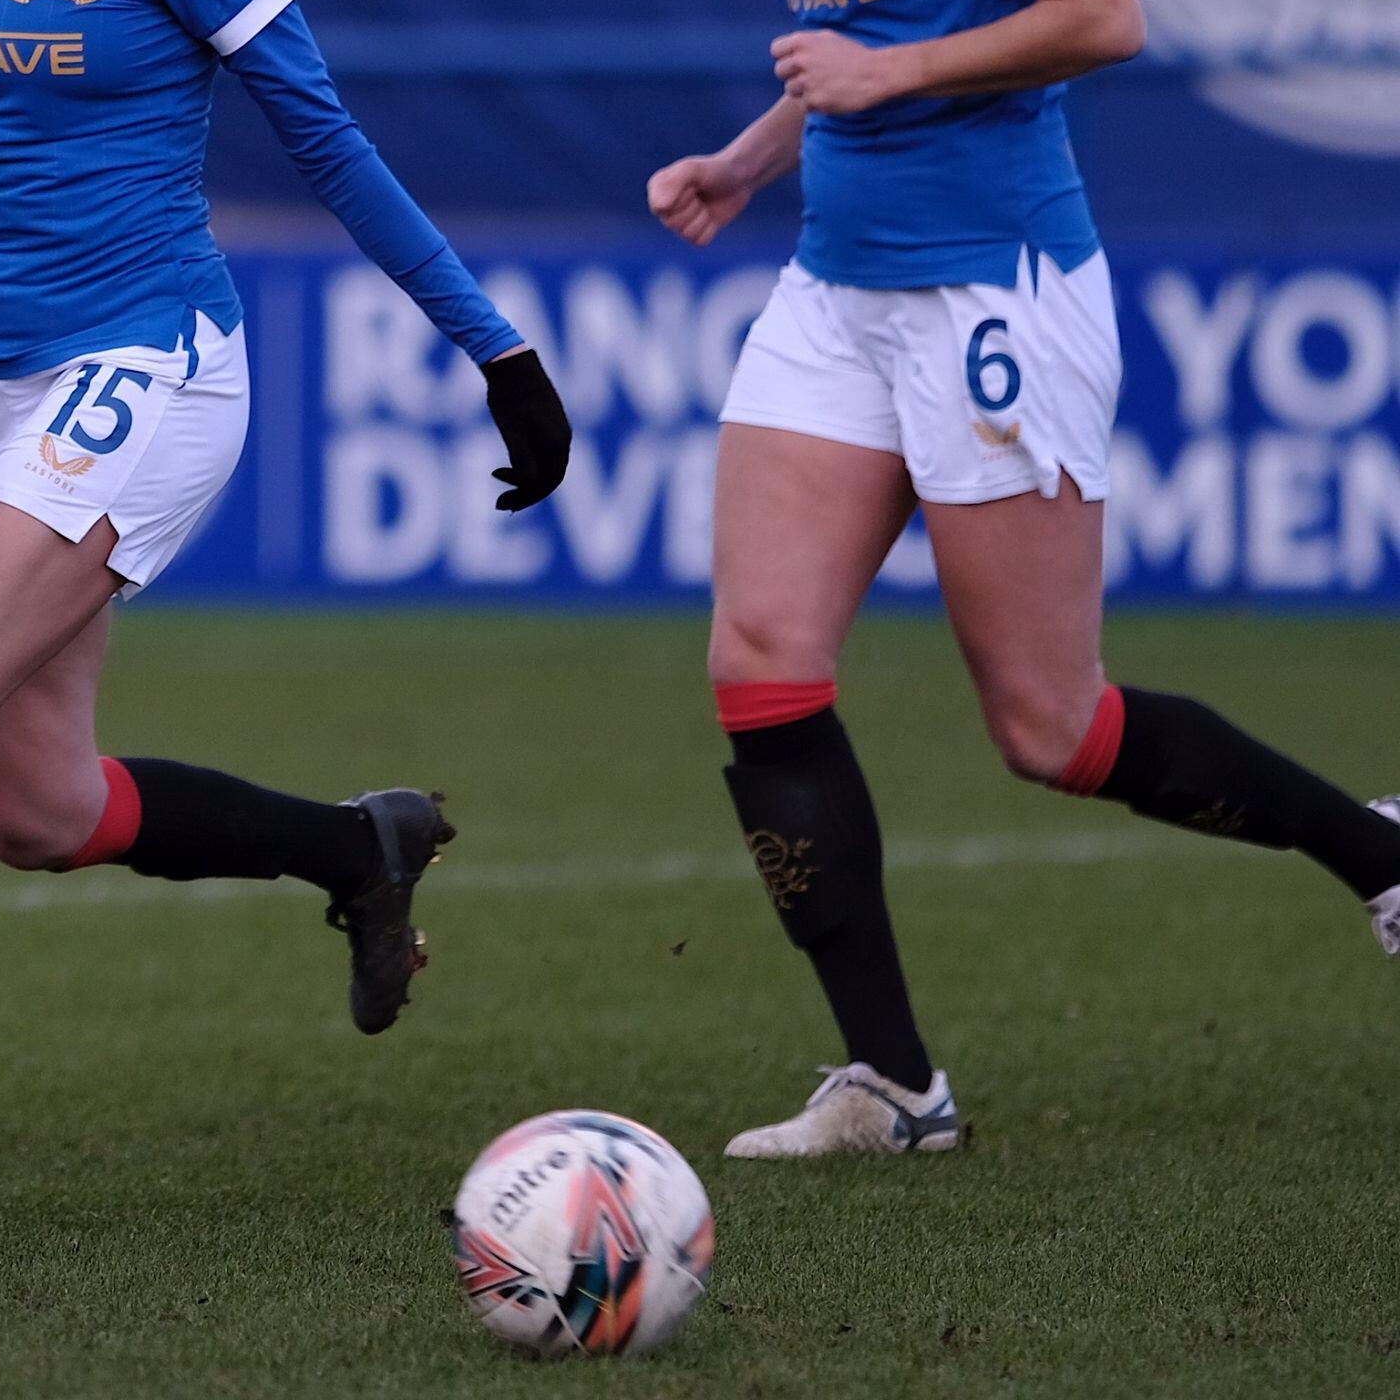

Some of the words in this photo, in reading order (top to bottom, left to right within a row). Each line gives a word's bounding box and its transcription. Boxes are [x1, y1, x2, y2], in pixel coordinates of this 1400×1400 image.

[966, 318, 1021, 411] 6
[1142, 268, 1400, 430] YO
[46, 364, 154, 455] 15
[24, 462, 76, 495] CASTORE
[490, 1150, 569, 1225] mitre
